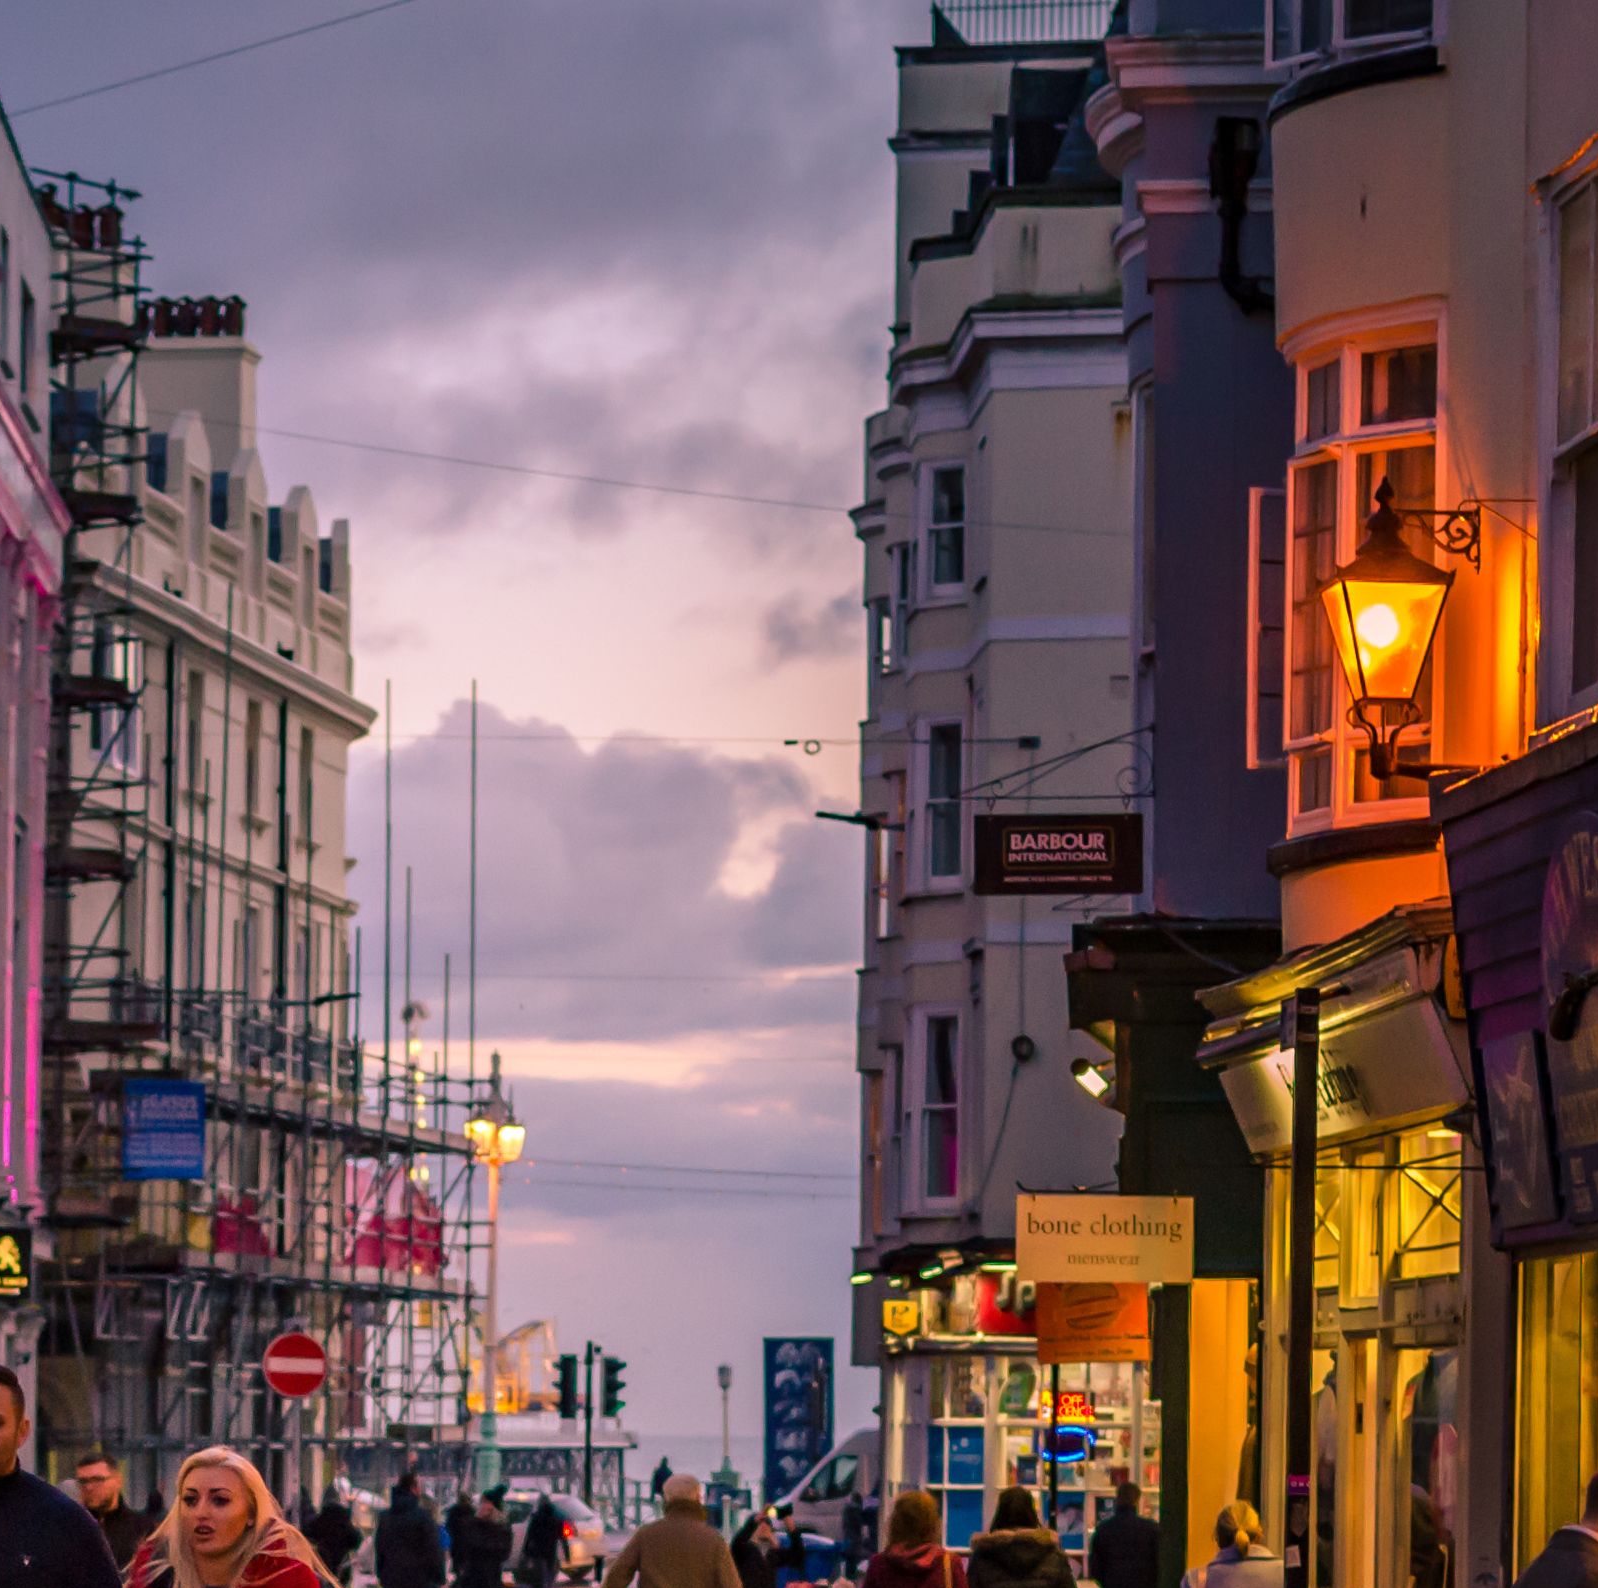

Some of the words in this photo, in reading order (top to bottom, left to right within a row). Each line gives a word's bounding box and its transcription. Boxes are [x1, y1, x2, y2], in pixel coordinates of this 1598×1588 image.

[1009, 832, 1105, 850] BARBOUR
[1007, 851, 1108, 863] INTERNATIONAL
[1027, 1212, 1082, 1236] bone
[1089, 1214, 1183, 1243] clothing
[1066, 1253, 1141, 1266] menswear
